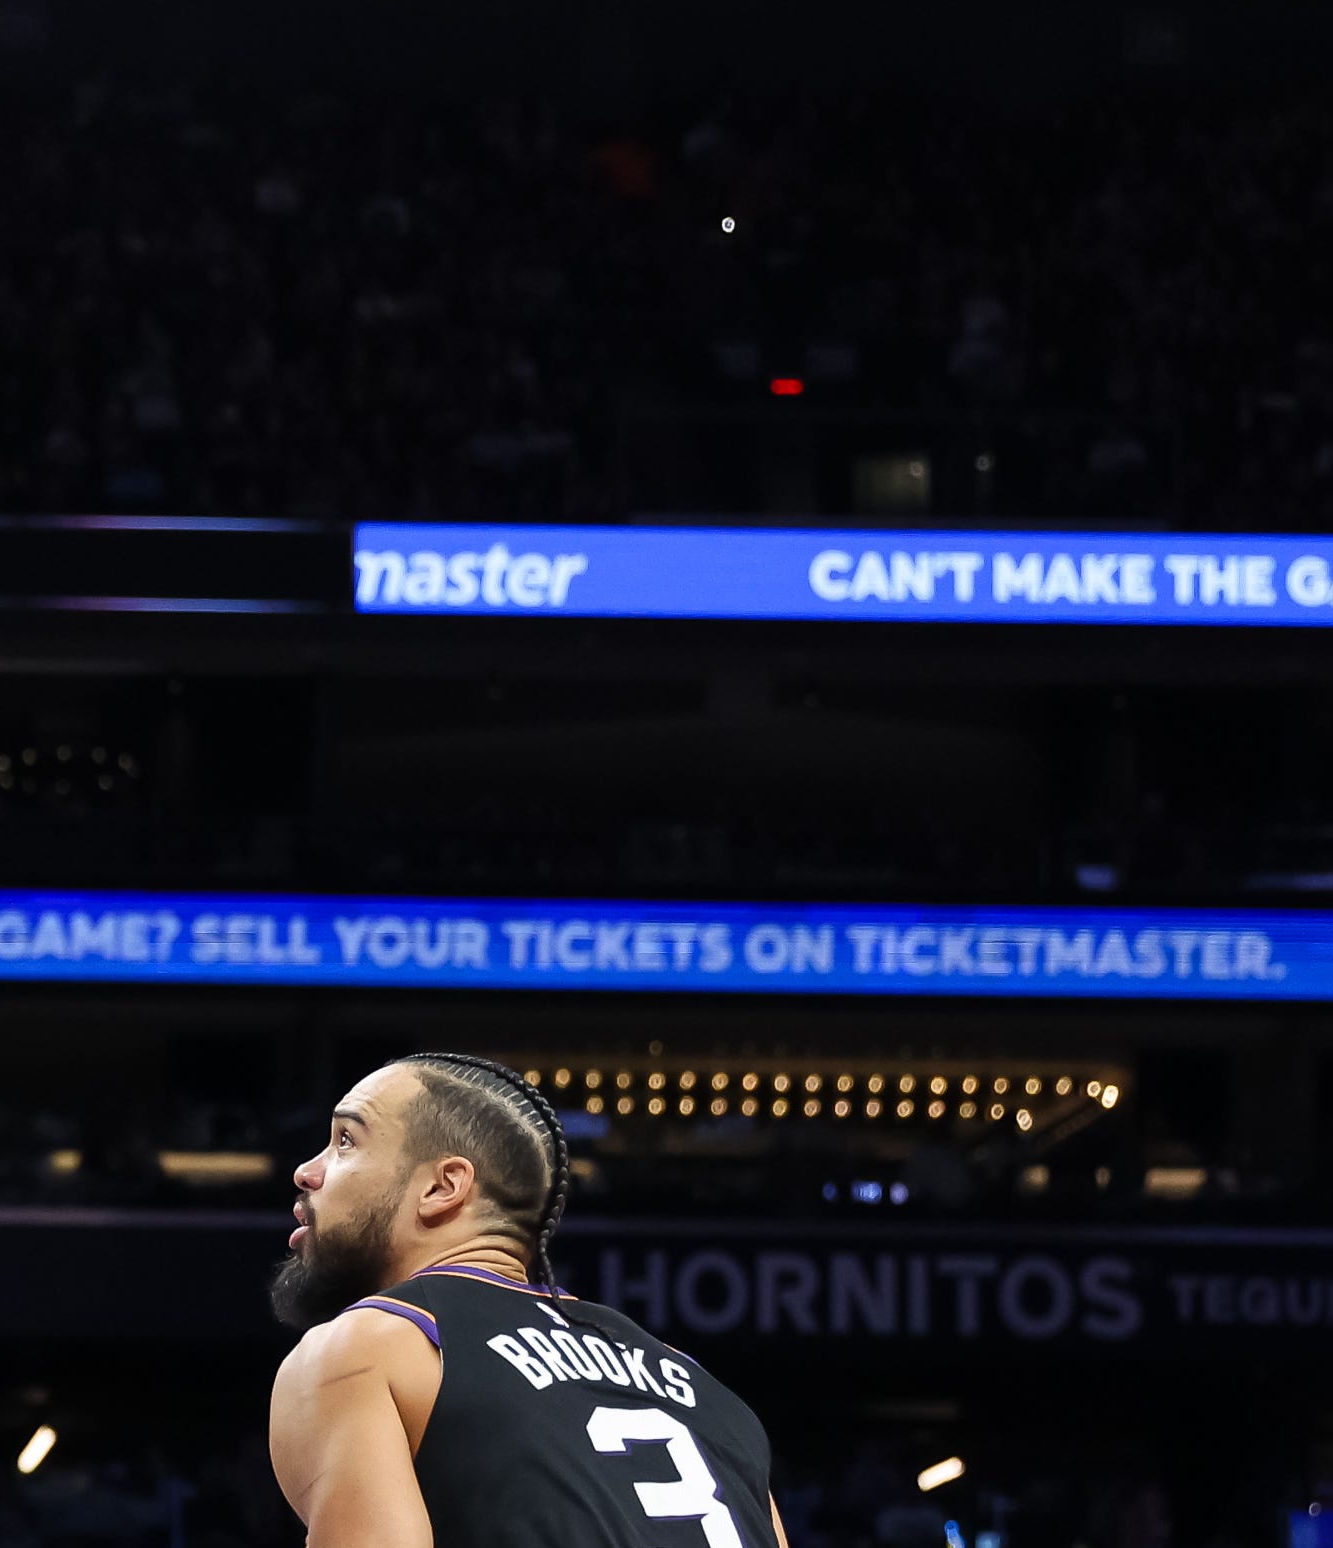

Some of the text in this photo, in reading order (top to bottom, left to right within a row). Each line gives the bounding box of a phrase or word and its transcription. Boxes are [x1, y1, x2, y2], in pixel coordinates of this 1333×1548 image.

[807, 551, 982, 602] CAN'T
[992, 552, 1156, 604] MAKE
[1164, 554, 1277, 607] THE
[191, 914, 320, 965] SELL
[334, 917, 488, 968] YOUR
[503, 920, 732, 972] TICKETS
[744, 924, 833, 974] ON
[847, 924, 1285, 981] TICKETMASTER.
[598, 1249, 1333, 1340] HORNITOS TEQU
[486, 1326, 697, 1408] BROOKS
